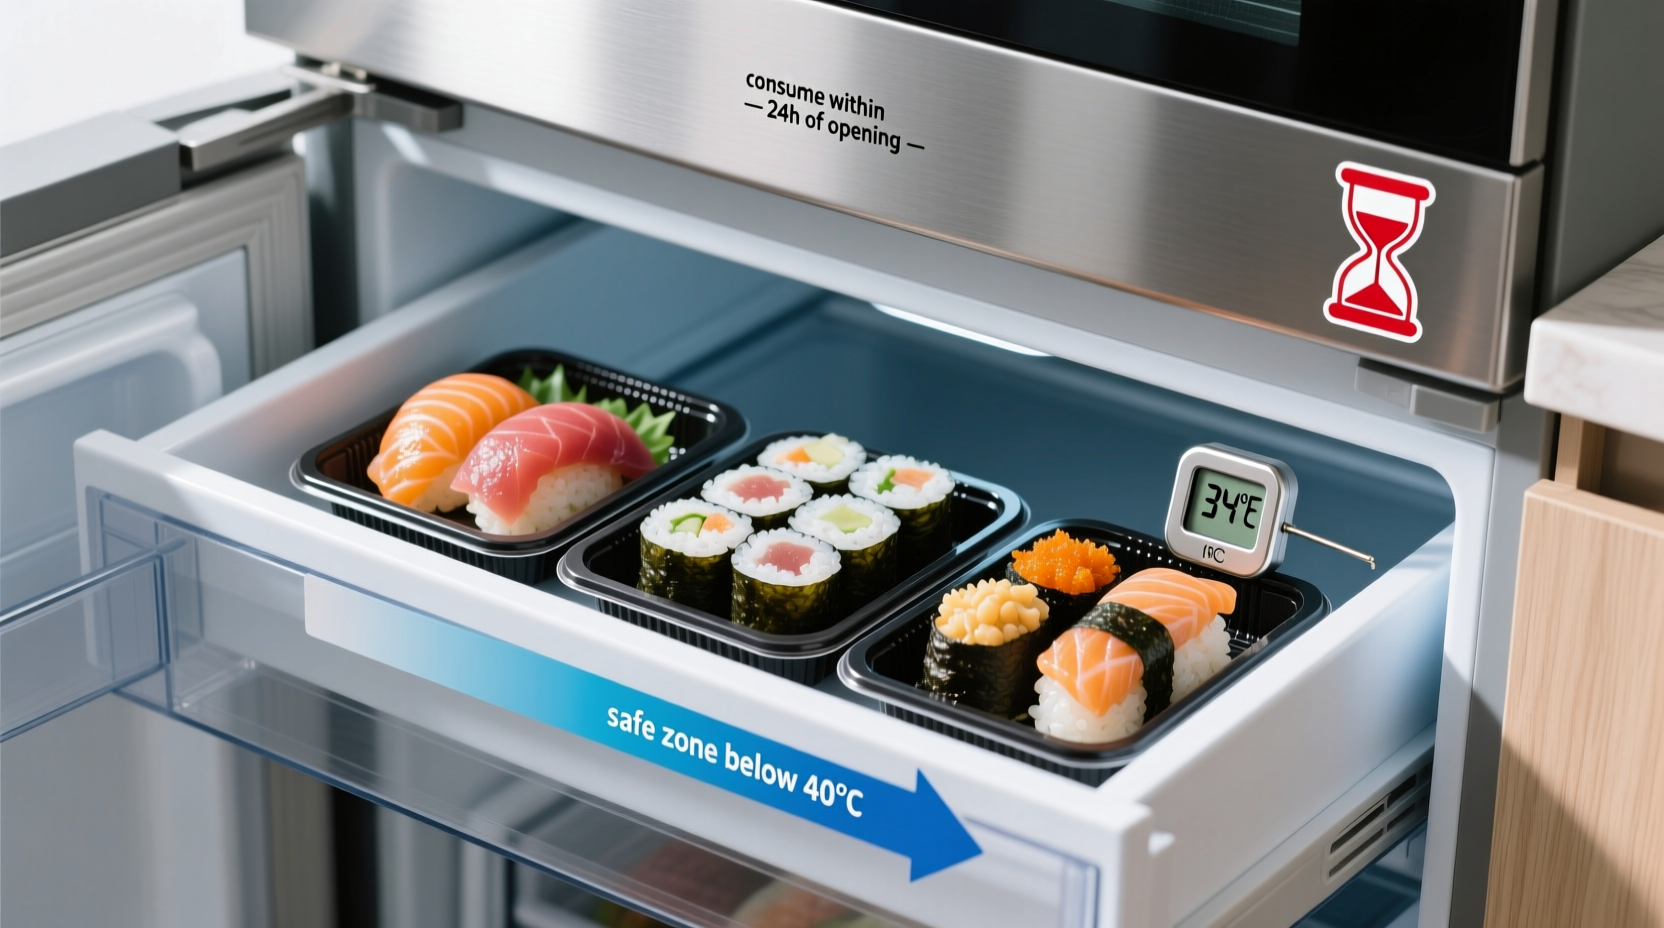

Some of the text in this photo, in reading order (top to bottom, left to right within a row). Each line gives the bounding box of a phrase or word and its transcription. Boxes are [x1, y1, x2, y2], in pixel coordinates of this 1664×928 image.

[746, 73, 885, 121] consume within
[767, 99, 800, 125] 24h
[805, 111, 825, 130] of
[828, 120, 901, 155] opening
[607, 707, 864, 818] safe zone below 40°C
